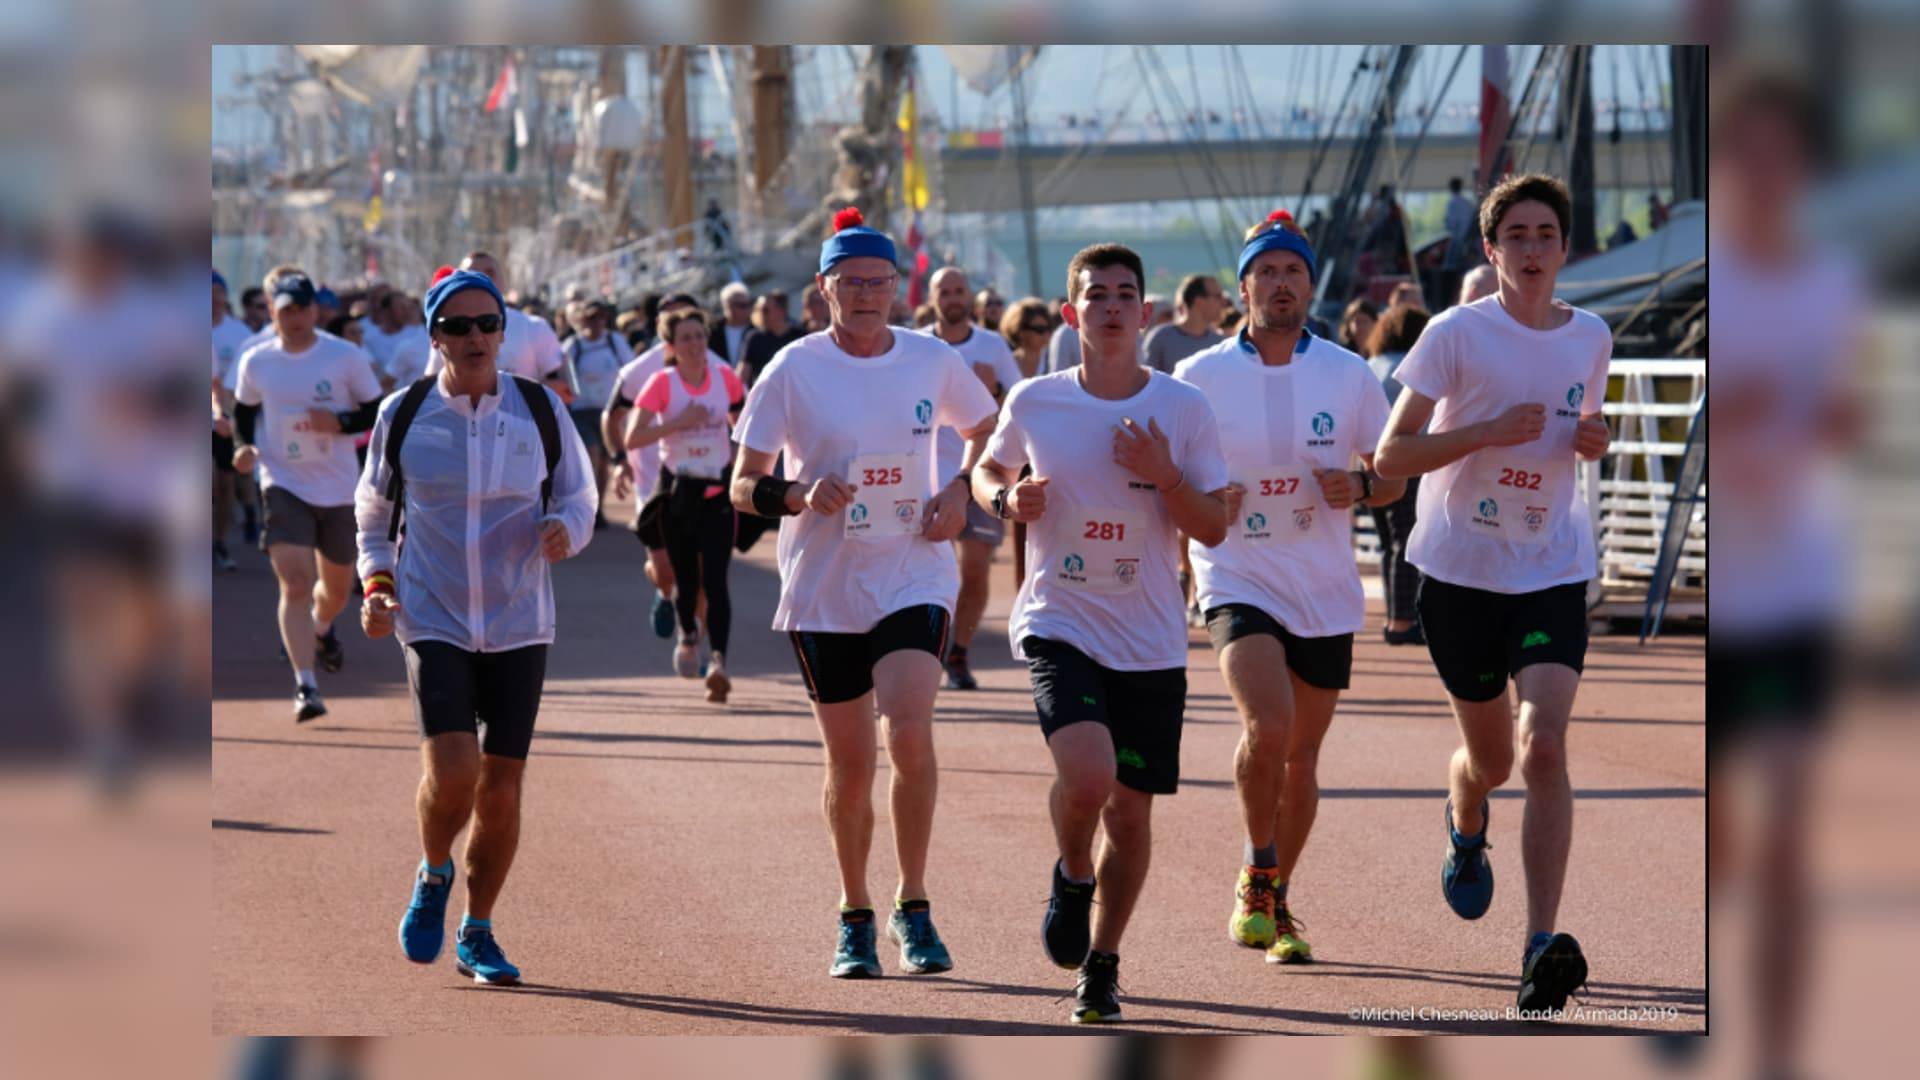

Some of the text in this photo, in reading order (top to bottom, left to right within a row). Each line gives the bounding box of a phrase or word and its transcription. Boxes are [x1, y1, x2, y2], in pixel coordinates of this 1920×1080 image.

[1312, 412, 1334, 436] 76
[862, 467, 903, 487] 325
[1259, 477, 1301, 497] 327
[1497, 467, 1543, 491] 282
[1083, 521, 1126, 542] 281
